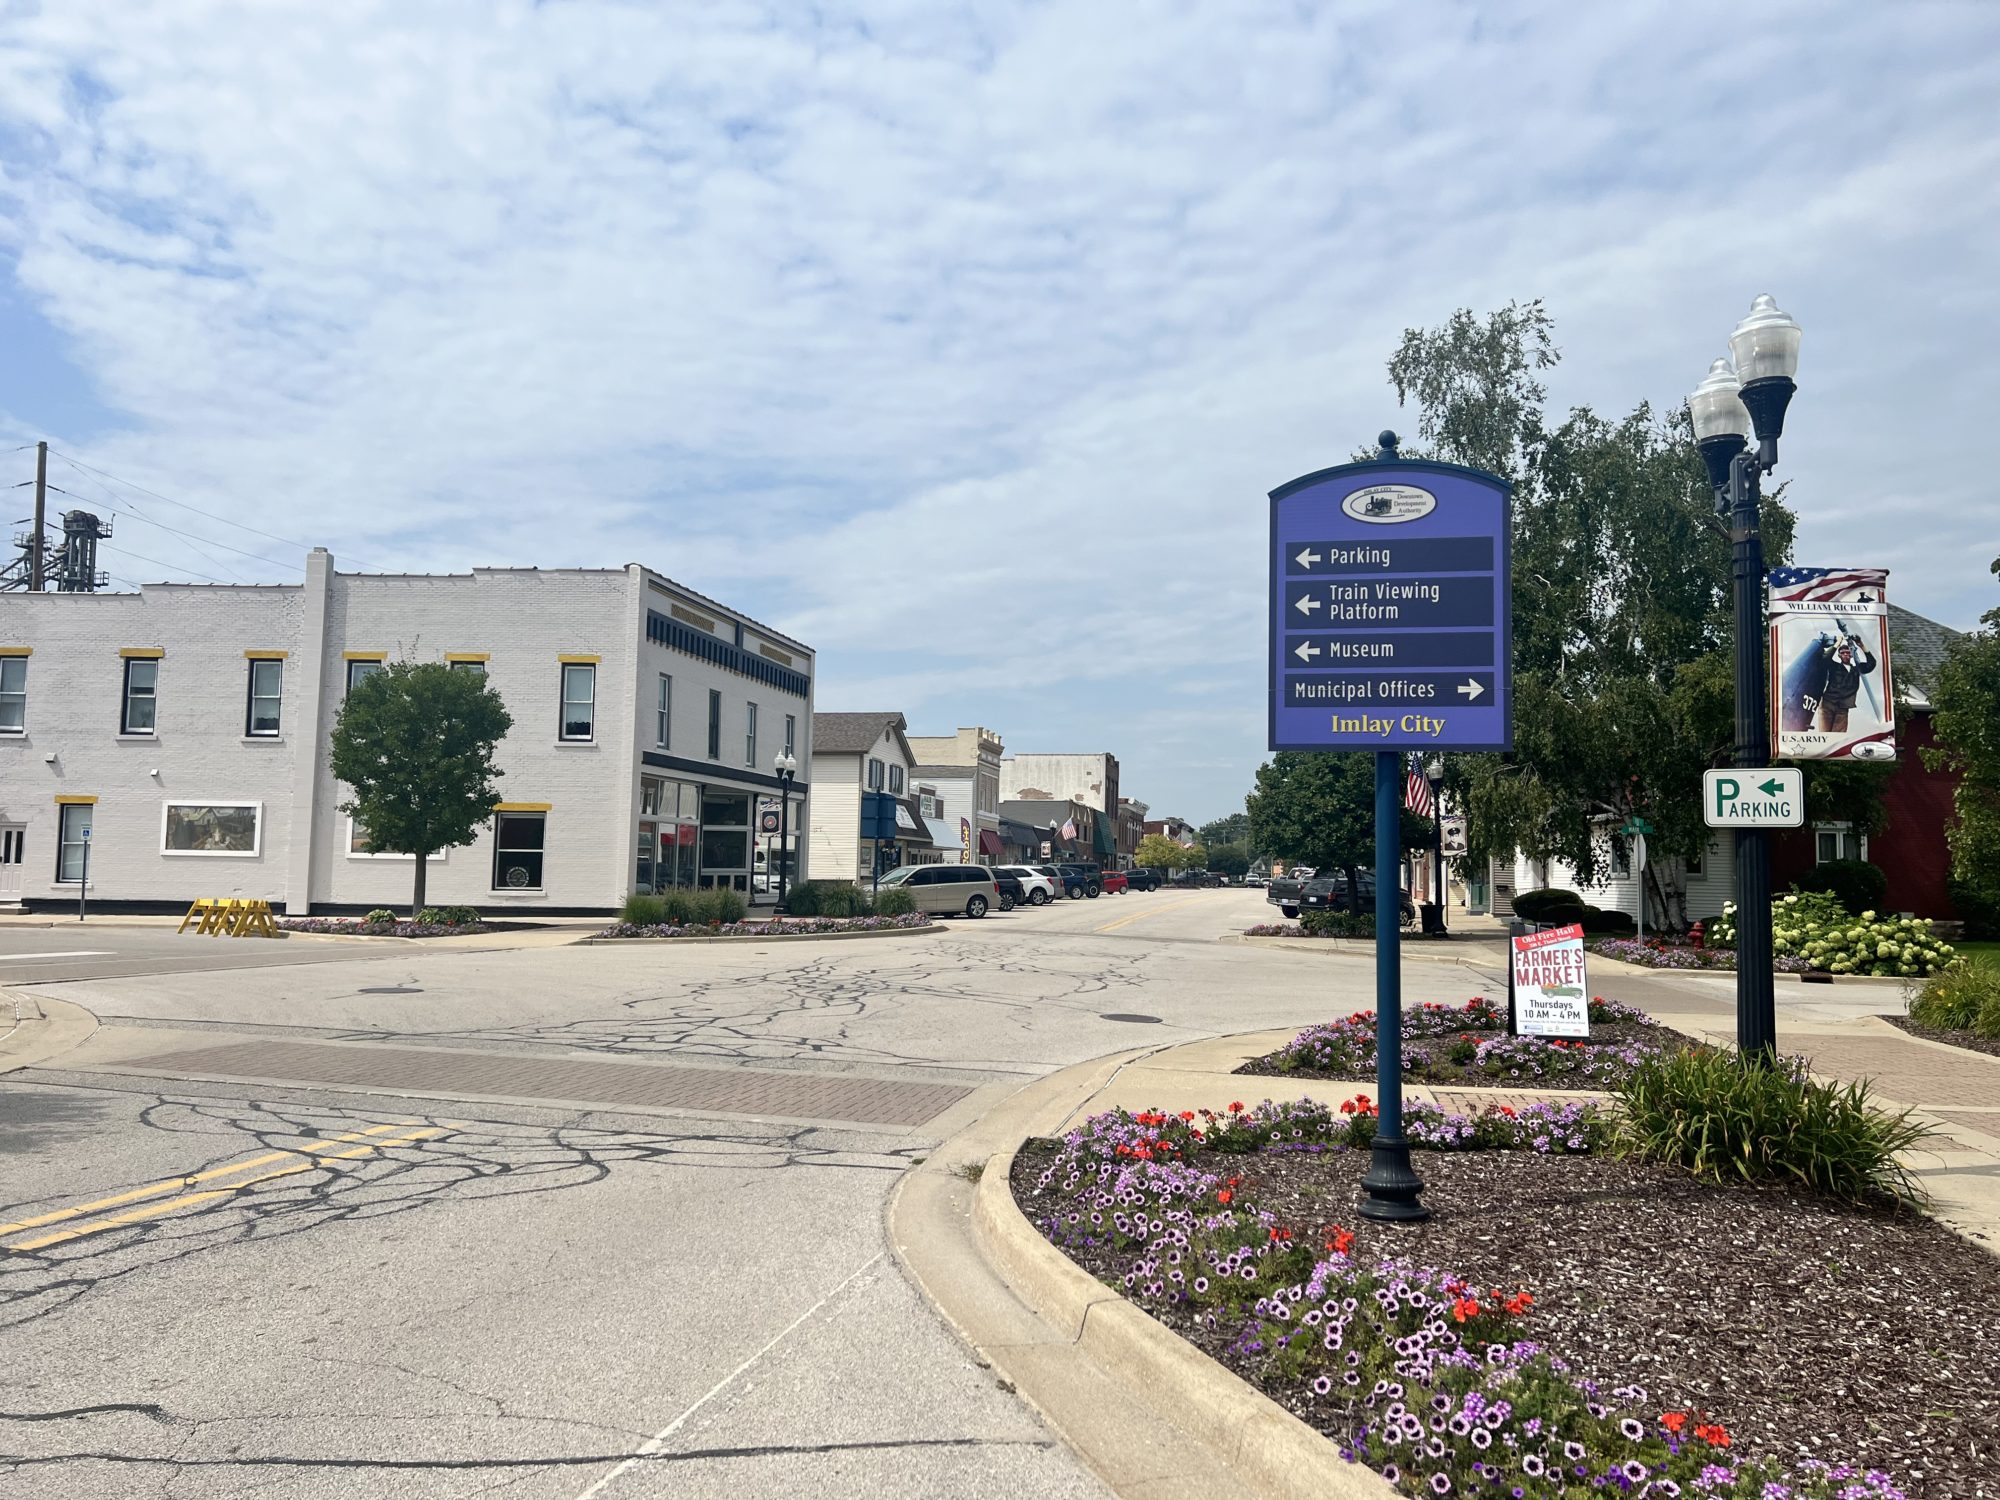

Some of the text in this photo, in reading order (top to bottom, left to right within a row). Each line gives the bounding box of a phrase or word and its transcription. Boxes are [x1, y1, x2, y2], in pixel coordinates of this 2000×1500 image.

[1330, 547, 1391, 567] Parking
[1330, 582, 1440, 602] Train Viewing
[1330, 604, 1399, 620] Platform
[1788, 603, 1869, 612] WILLIAM RICHEY
[1330, 642, 1395, 658] Museum
[1295, 680, 1435, 702] Municipal Offices
[1802, 694, 1817, 713] 372
[1331, 714, 1446, 737] Imlay City
[1716, 778, 1791, 818] PARKING
[1521, 926, 1575, 944] Old Fire Hall
[1515, 948, 1583, 967] FARMER'S
[1516, 965, 1583, 987] MARKET
[1524, 1009, 1534, 1018] 10
[1536, 1010, 1549, 1019] AM
[1559, 1010, 1565, 1019] 4
[1567, 1010, 1581, 1020] PM
[1529, 1000, 1574, 1010] Thursdays
